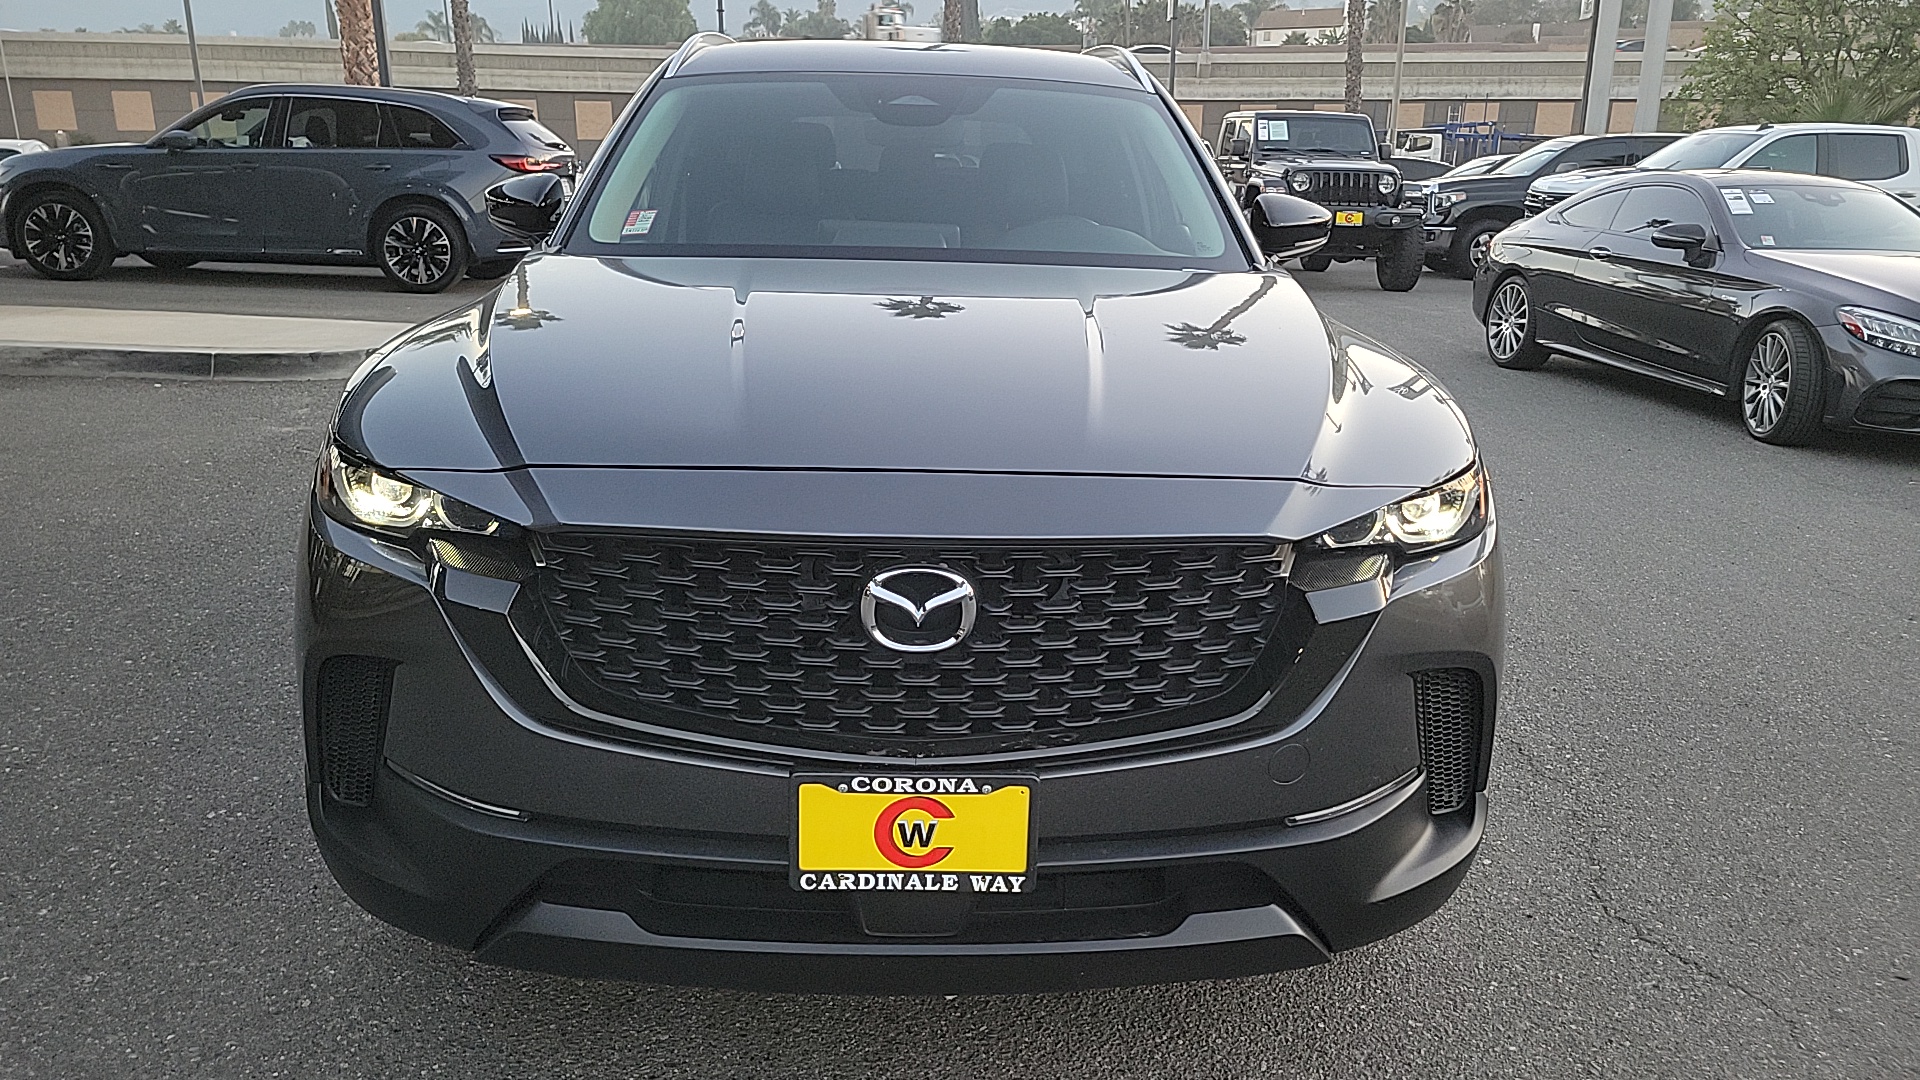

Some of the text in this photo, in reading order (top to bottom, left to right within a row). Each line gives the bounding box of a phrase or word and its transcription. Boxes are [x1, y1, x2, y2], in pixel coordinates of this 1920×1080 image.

[851, 777, 979, 793] CORONA
[799, 873, 1027, 893] CARDINALE WAY
